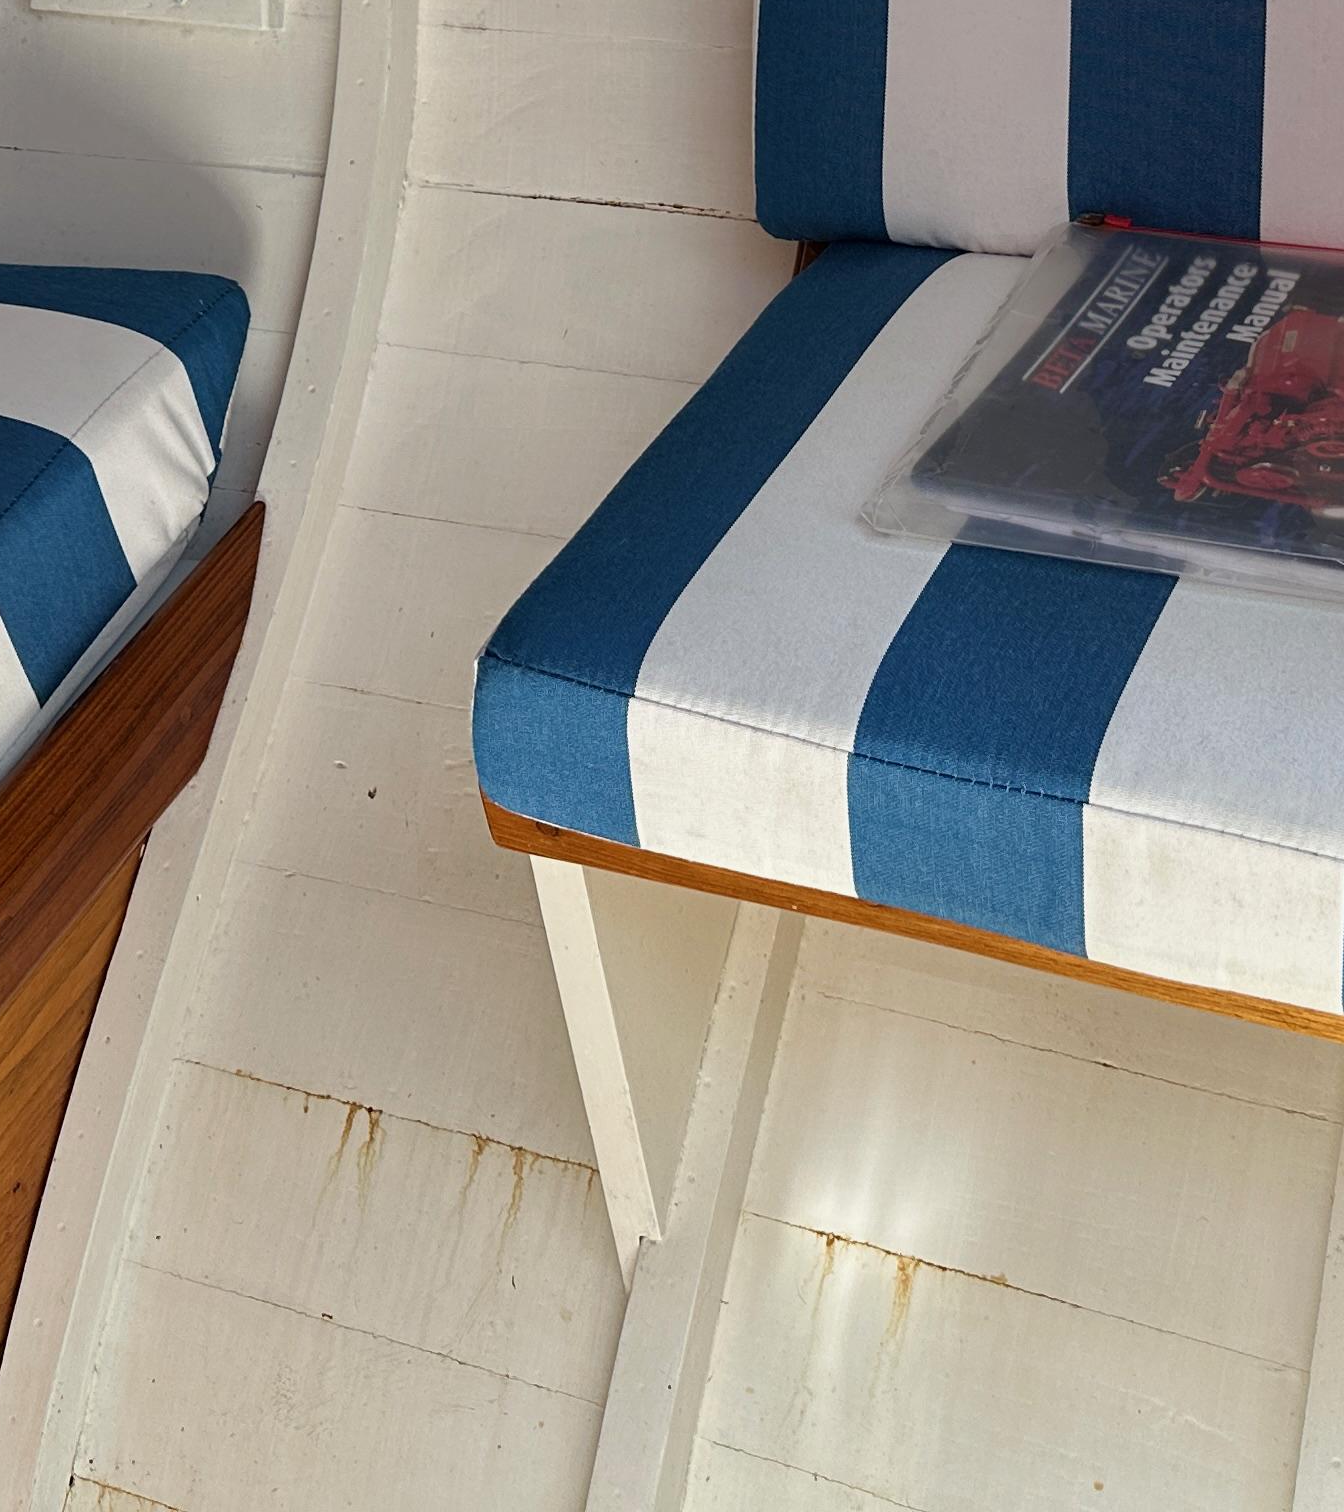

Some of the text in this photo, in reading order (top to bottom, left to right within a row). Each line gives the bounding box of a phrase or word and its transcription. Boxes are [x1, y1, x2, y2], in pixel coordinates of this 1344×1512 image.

[1032, 246, 1162, 388] BETA MARINE
[1126, 255, 1217, 351] Operators
[1143, 262, 1259, 388] Maintenance
[1225, 268, 1301, 344] Manual
